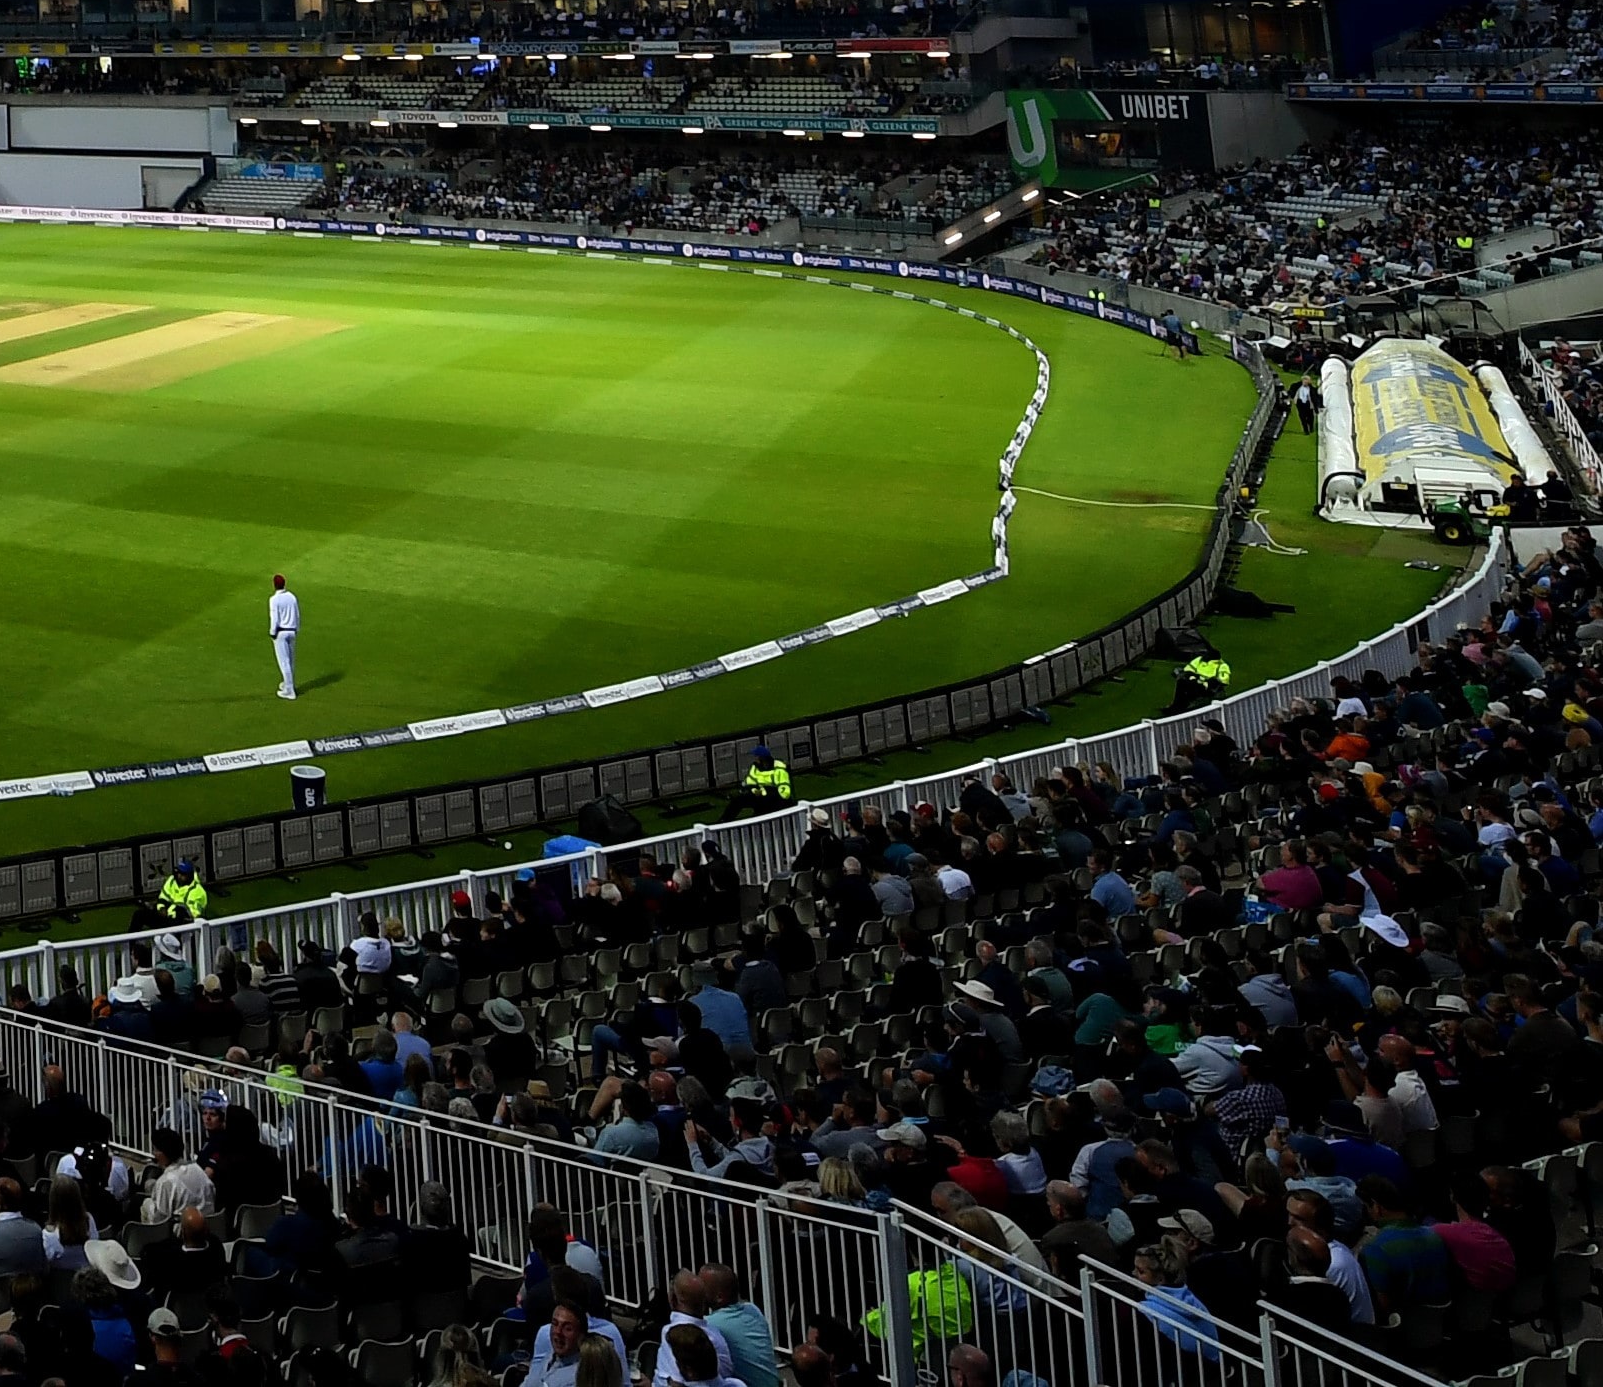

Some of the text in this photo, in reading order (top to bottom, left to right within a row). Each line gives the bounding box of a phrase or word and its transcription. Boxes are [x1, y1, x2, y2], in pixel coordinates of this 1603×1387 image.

[1121, 94, 1189, 119] UNIBET
[401, 113, 437, 121] TOYOTA
[464, 114, 499, 122] TOYOTA
[510, 115, 538, 123] GREENE
[585, 116, 641, 125] GREENE KING
[644, 117, 701, 126] GREENE KING
[725, 119, 783, 128] GREENE KING
[787, 120, 847, 129] GREENE KING
[872, 121, 935, 132] GREENE KING
[324, 737, 362, 751] Investec
[217, 751, 257, 765] Investec
[102, 767, 146, 782] Investec
